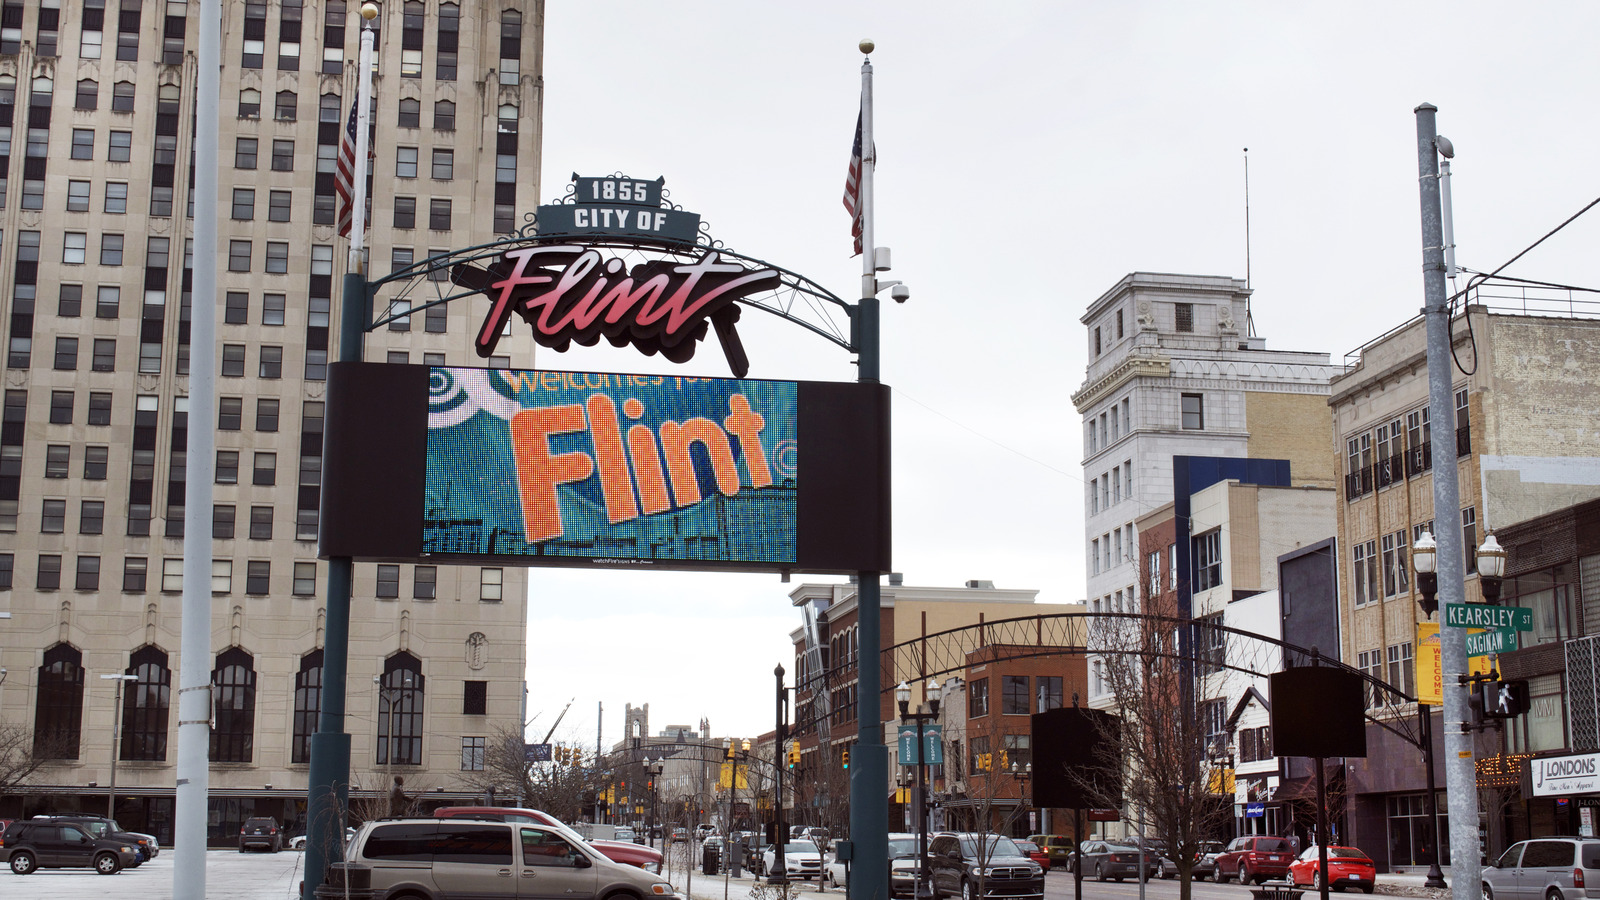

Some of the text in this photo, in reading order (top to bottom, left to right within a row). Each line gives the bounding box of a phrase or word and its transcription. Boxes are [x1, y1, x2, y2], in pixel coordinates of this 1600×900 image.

[592, 180, 647, 202] 1855
[574, 208, 667, 232] CITY OF
[480, 245, 778, 346] Flint
[510, 393, 773, 544] Flint
[1448, 606, 1531, 627] KEARSLEY ST
[1467, 631, 1515, 655] SAGINAW ST
[1432, 647, 1442, 696] WELCOME
[1546, 758, 1596, 777] LONDONS
